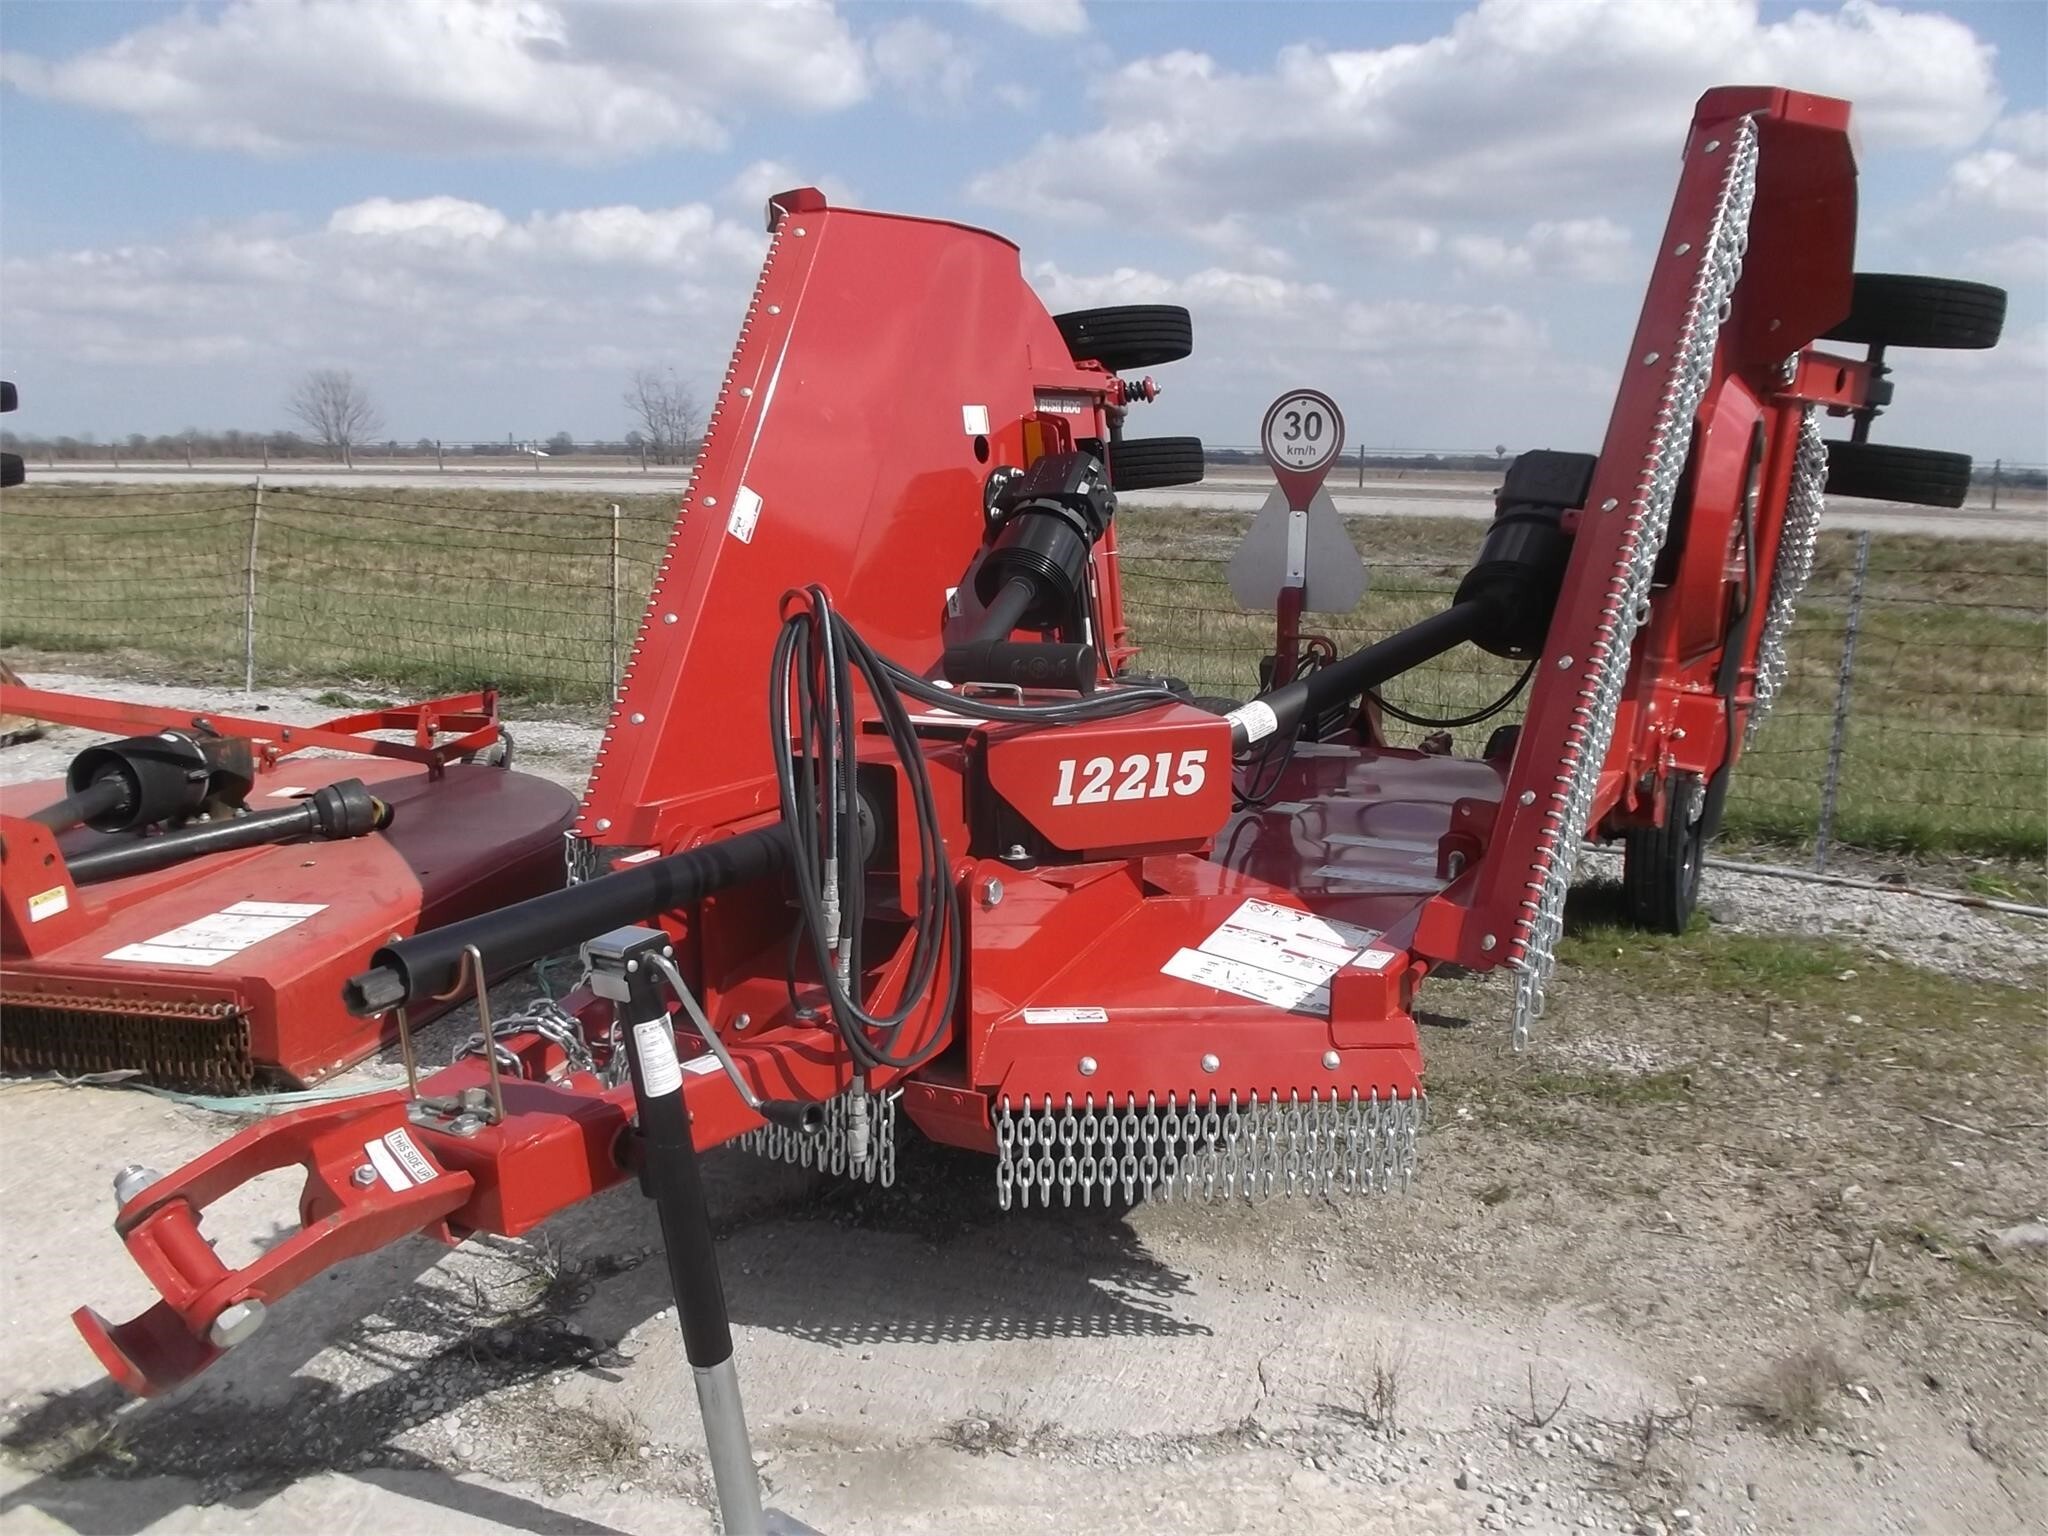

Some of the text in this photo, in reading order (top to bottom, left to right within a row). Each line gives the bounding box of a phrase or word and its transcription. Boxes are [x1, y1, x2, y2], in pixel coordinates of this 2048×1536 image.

[1283, 411, 1322, 441] 30
[1287, 445, 1316, 457] km/h
[1051, 749, 1208, 807] 12215
[392, 1134, 431, 1178] THIS SIDE UP
